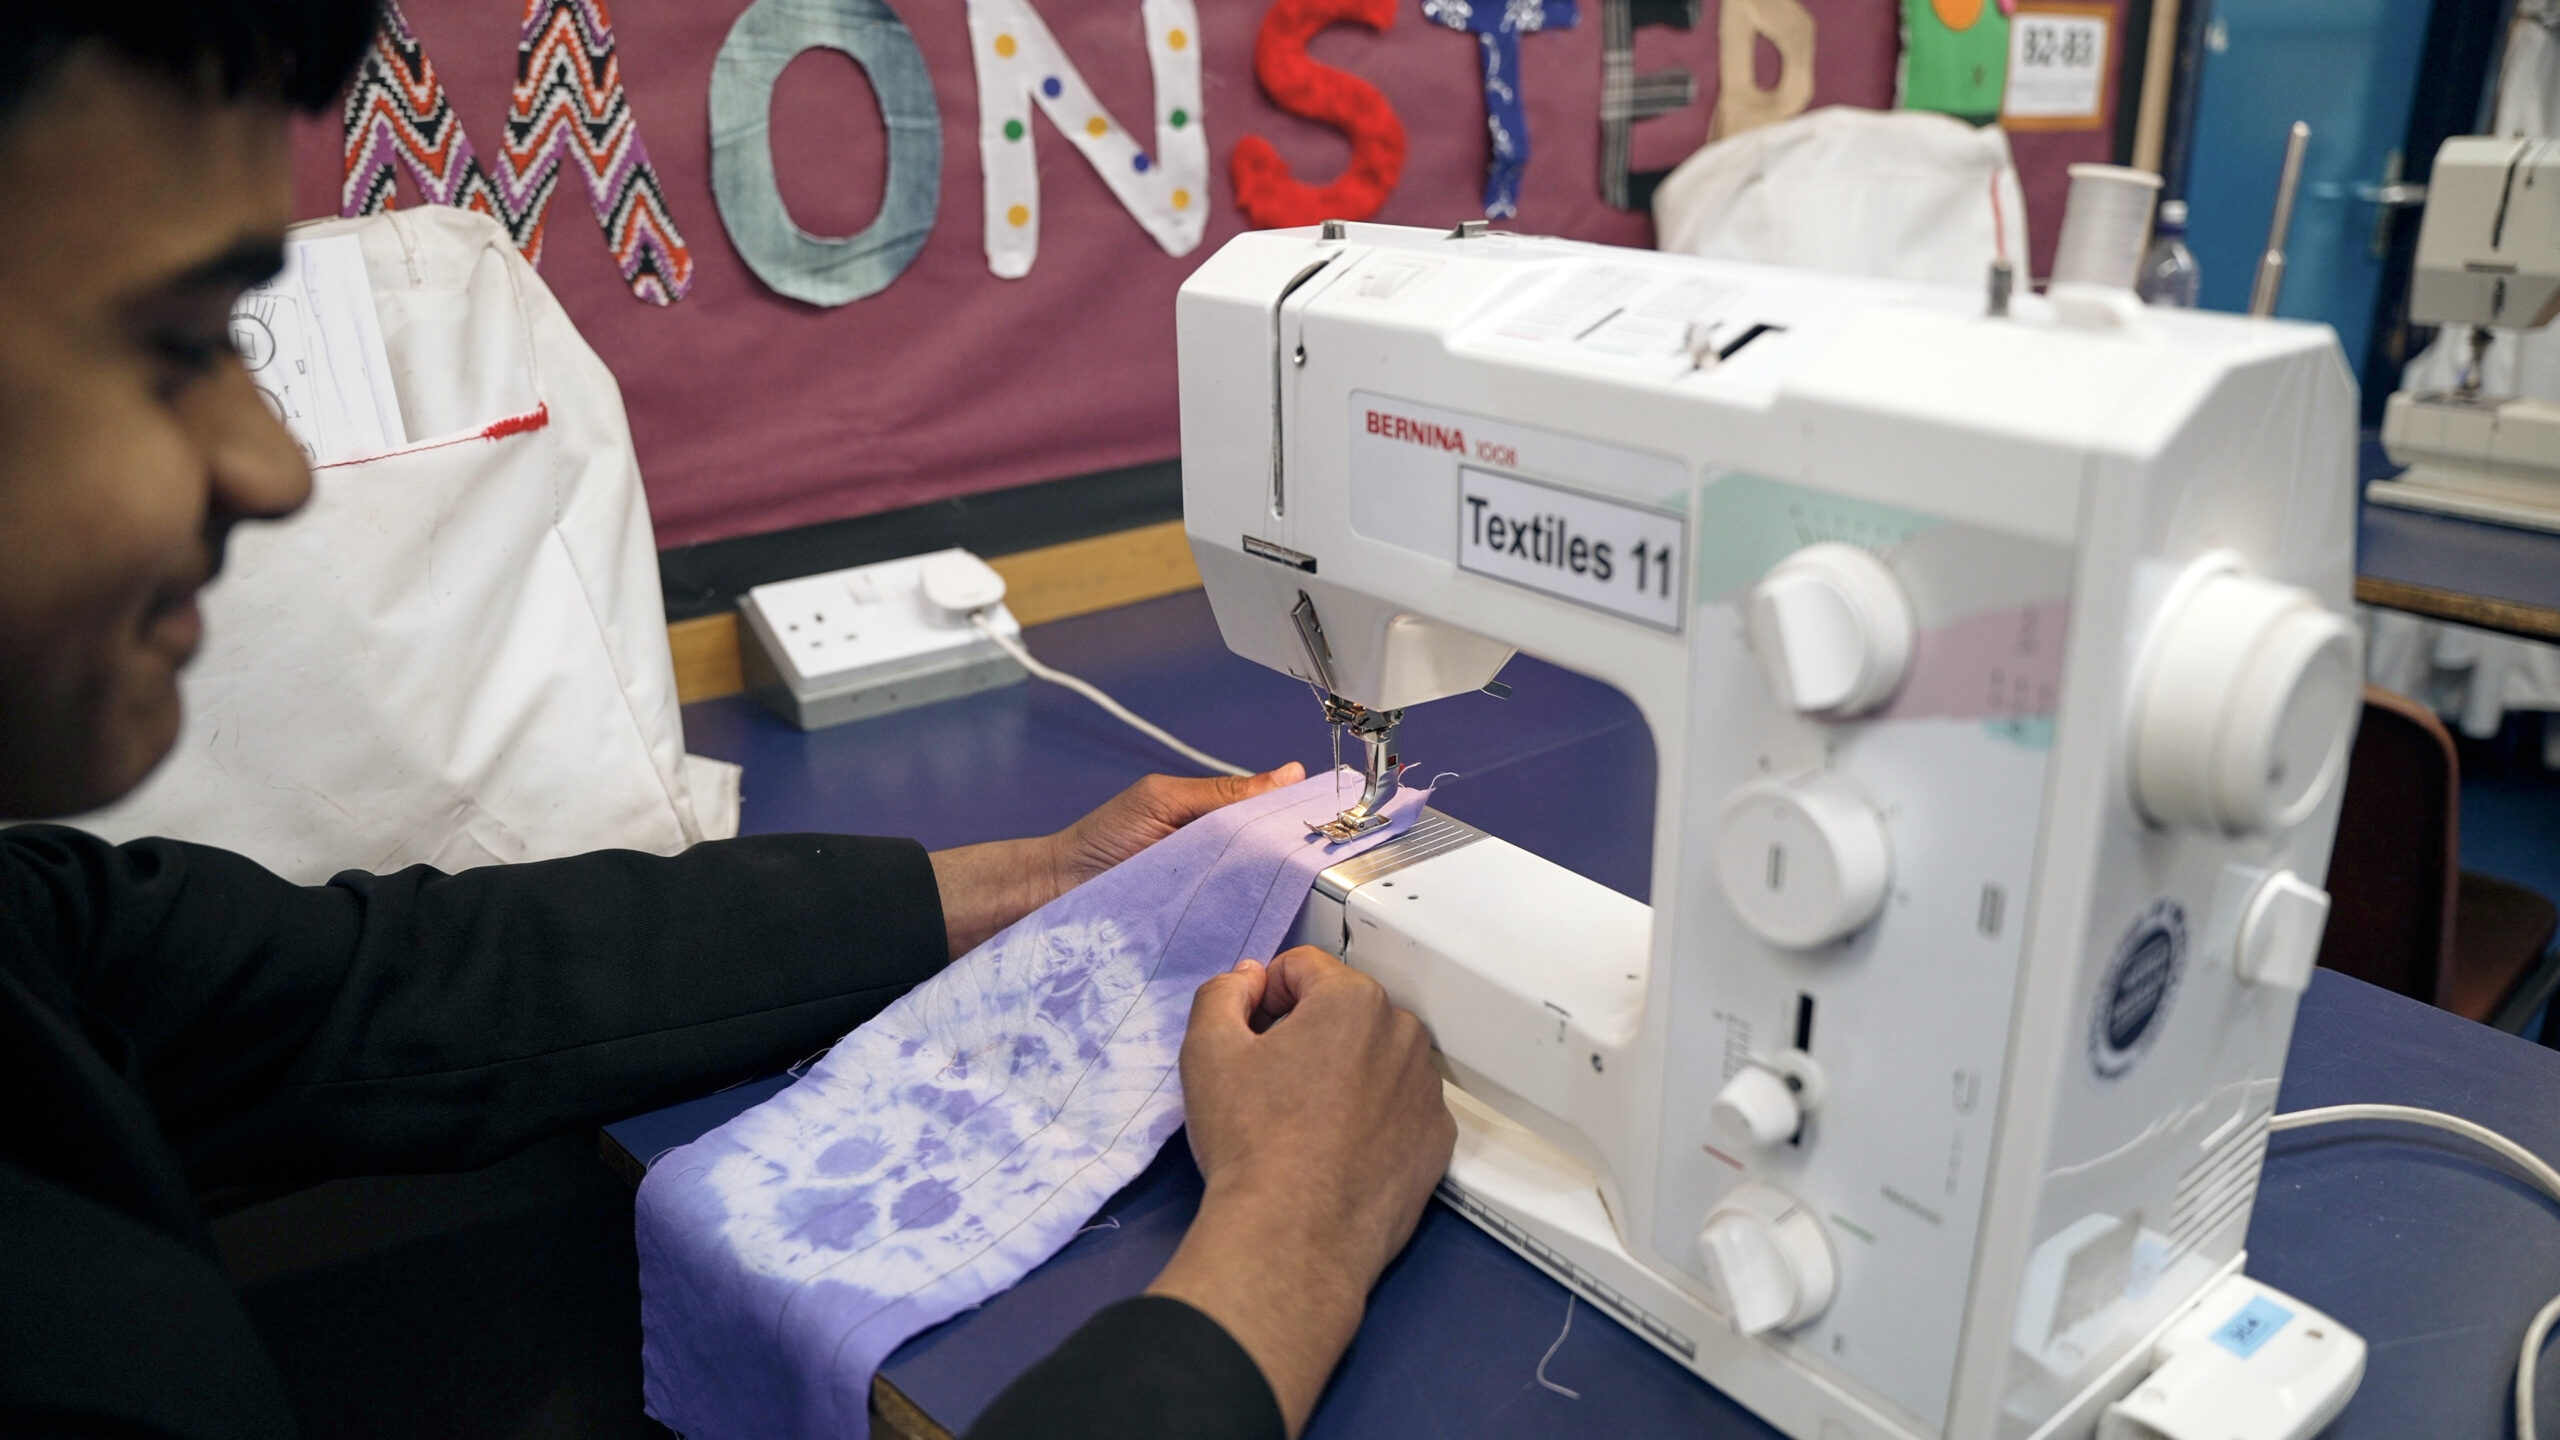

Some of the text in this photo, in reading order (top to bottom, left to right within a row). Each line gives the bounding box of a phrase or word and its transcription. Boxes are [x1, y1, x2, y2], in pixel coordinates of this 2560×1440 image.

[1366, 410, 1467, 455] BERNINA
[1466, 495, 1671, 600] Textiles 11
